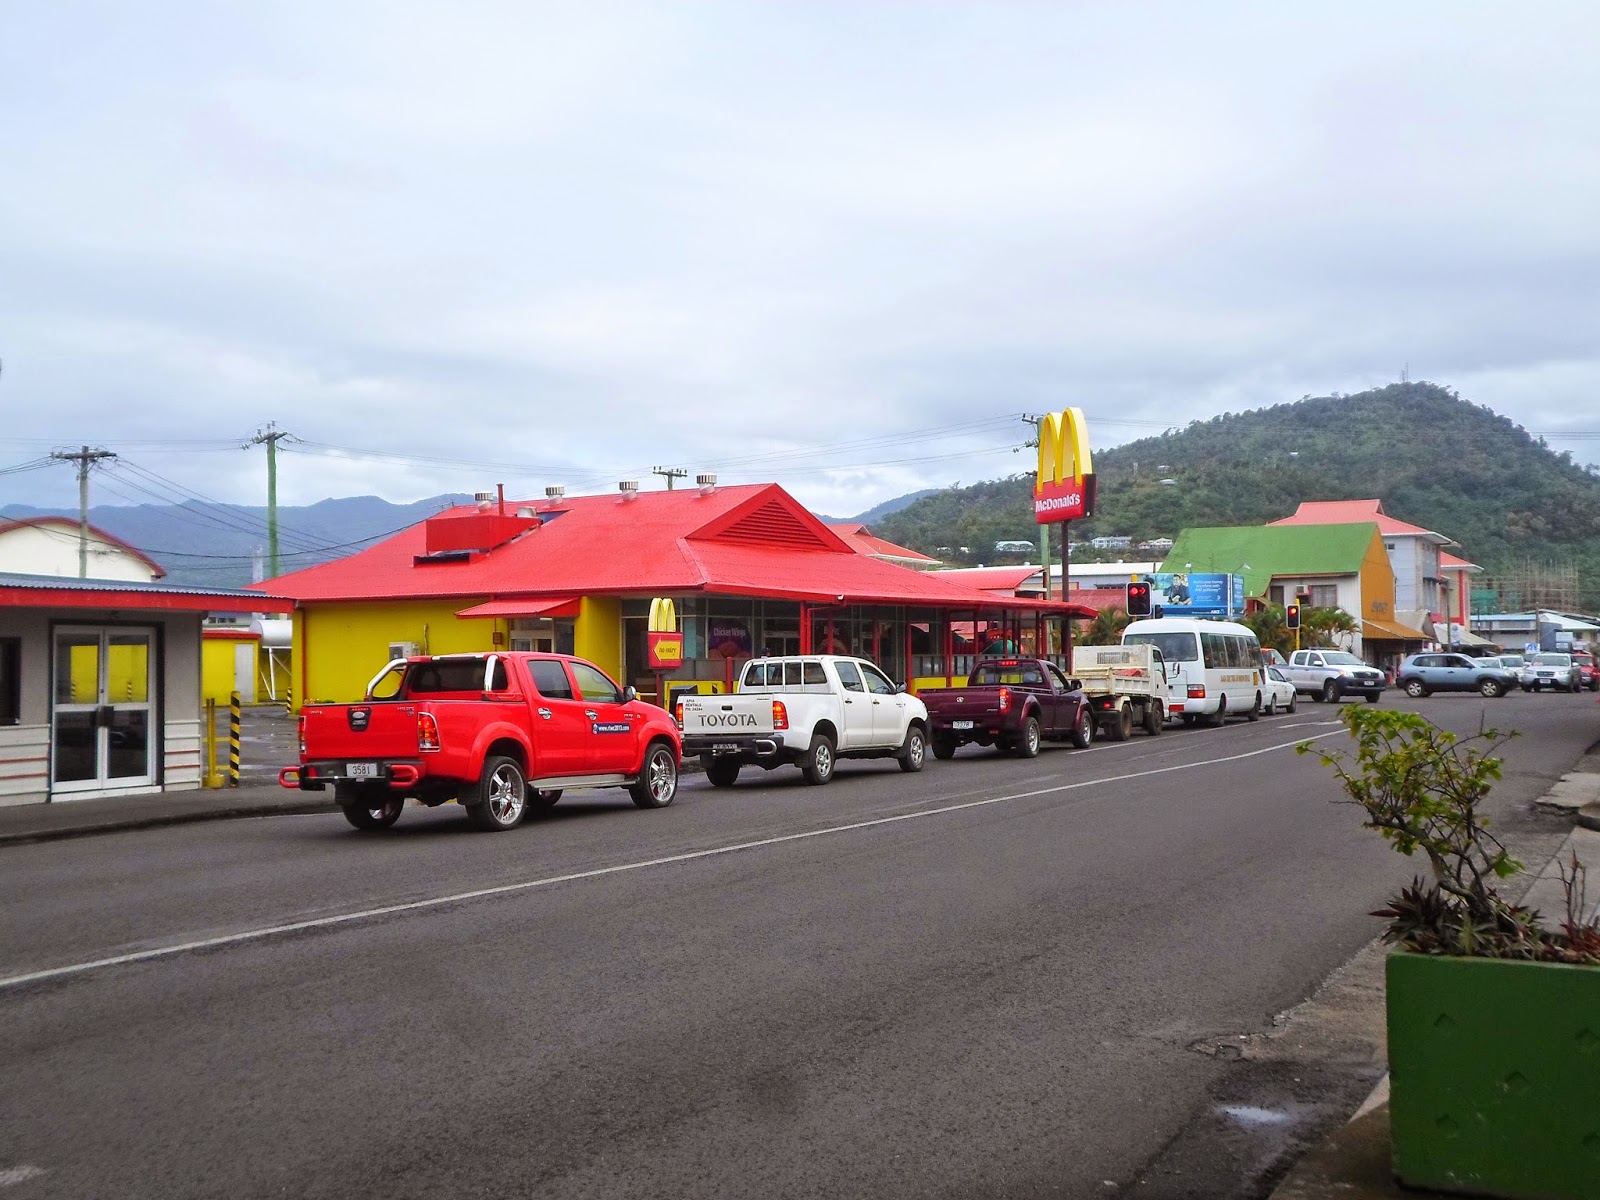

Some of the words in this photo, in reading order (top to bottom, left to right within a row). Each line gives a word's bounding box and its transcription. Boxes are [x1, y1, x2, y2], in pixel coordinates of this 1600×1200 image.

[1035, 492, 1081, 513] McDonald's
[713, 627, 731, 636] Chicken
[731, 628, 746, 638] Wings
[698, 714, 757, 727] TOYOTA
[352, 766, 370, 775] 3581
